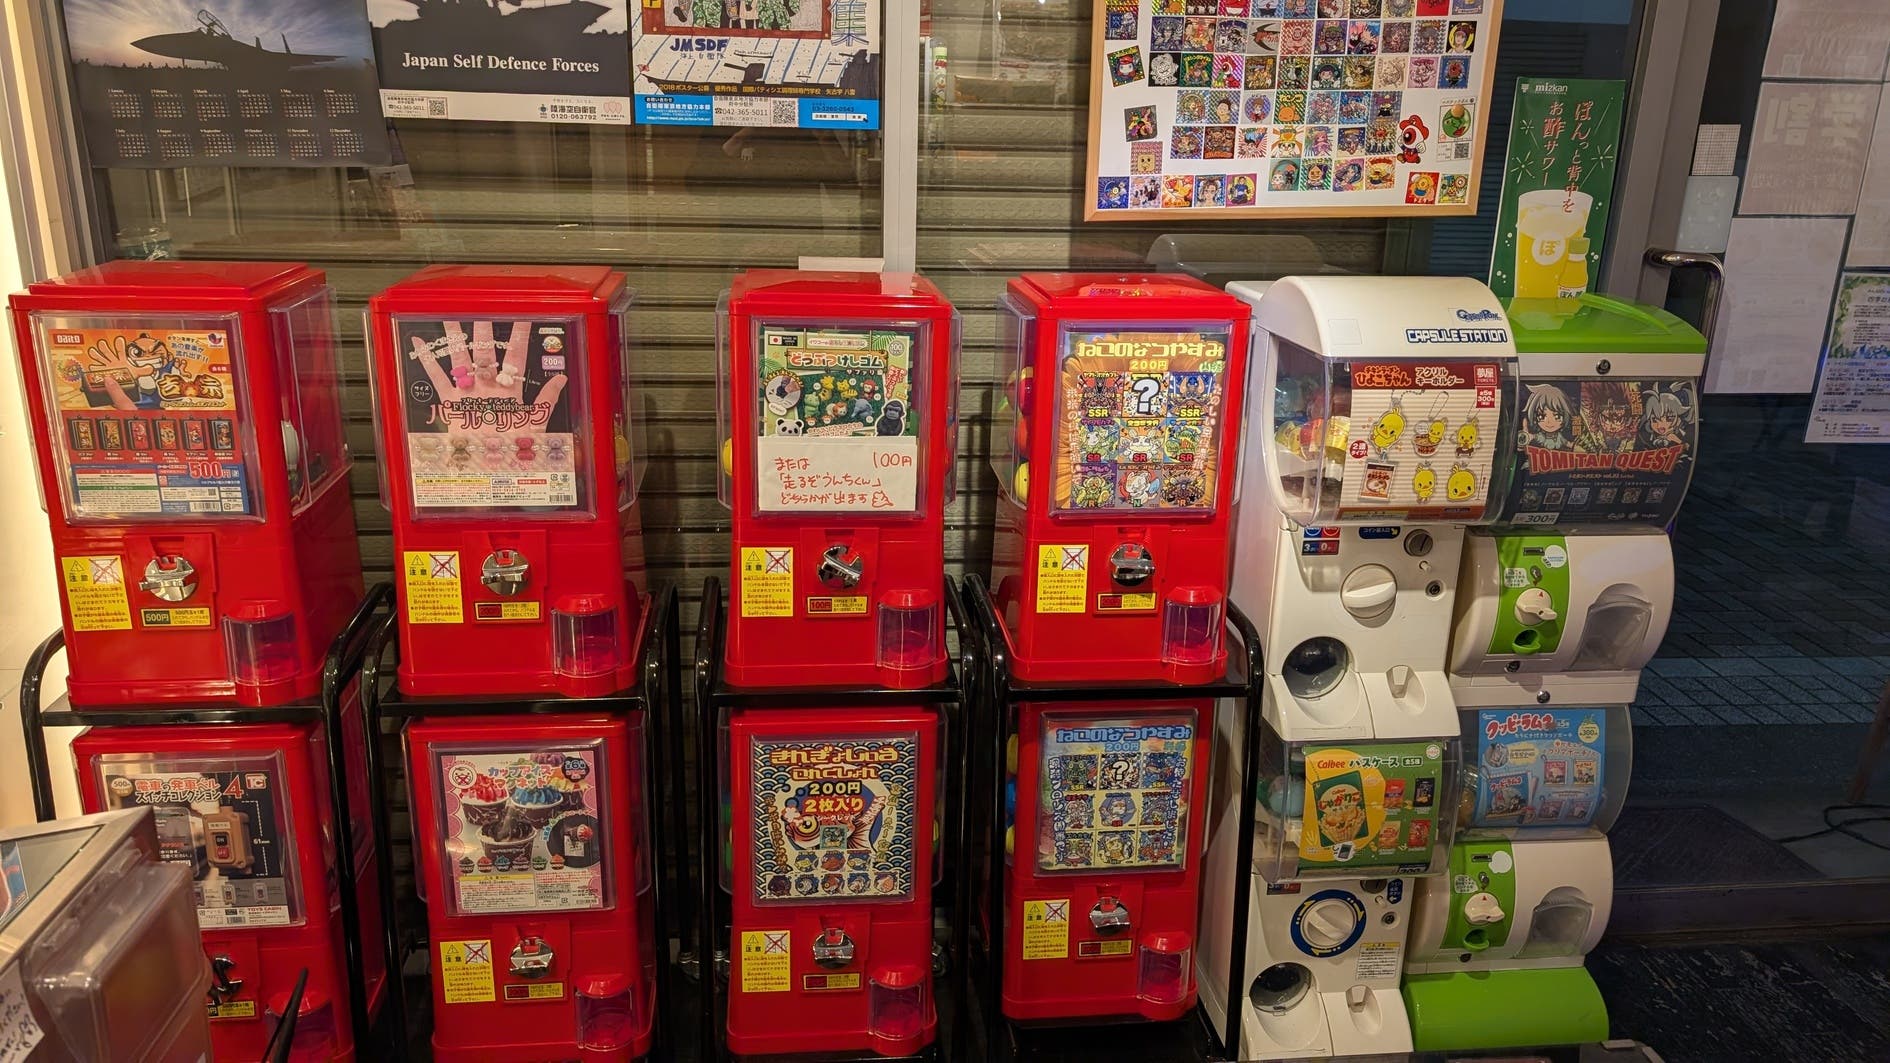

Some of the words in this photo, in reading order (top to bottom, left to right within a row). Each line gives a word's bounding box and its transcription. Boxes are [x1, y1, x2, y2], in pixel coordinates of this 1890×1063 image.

[670, 38, 728, 52] JMSDF
[402, 52, 448, 68] Japan
[453, 54, 483, 69] Self
[487, 55, 547, 71] Defence
[552, 57, 600, 73] Forces
[1535, 83, 1568, 92] mizkan
[551, 112, 597, 121] 0120-063792
[722, 108, 768, 116] 042-365-5011
[1542, 101, 1566, 186] お酢サワー
[1406, 329, 1459, 343] CAPSULE
[1461, 329, 1507, 343] STATION
[1078, 343, 1223, 357] ねこのなつやすみ
[789, 352, 884, 367] どうぶつけしゴム
[1130, 361, 1168, 371] 200円
[1416, 368, 1447, 376] アクリル
[1356, 373, 1411, 386] ひよこちゃん
[1416, 377, 1464, 386] キーホルダー
[452, 403, 485, 412] Flocky
[492, 404, 533, 412] teddybear
[1088, 408, 1108, 417] SSR
[1180, 408, 1200, 417] SSR
[774, 457, 811, 471] または
[873, 452, 912, 467] 100円
[1133, 454, 1147, 462] SR
[1180, 454, 1193, 462] SR
[1527, 446, 1614, 474] TOMITAN
[1616, 445, 1682, 473] QUEST
[188, 461, 231, 479] 500円
[811, 601, 831, 609] 100円
[146, 613, 169, 622] 500円
[1056, 726, 1191, 743] ねこのなつやすみ
[1106, 743, 1140, 751] 200円
[1317, 759, 1345, 769] Calbee
[1349, 756, 1399, 768] パスケース
[488, 765, 552, 777] カップアイス
[135, 779, 220, 791] 電車の発車ベル
[223, 775, 244, 798] 4
[494, 778, 551, 788] マグネット
[809, 782, 861, 795] 200円
[136, 790, 222, 803] スイッチコレクション
[805, 797, 864, 813] 2枚入り
